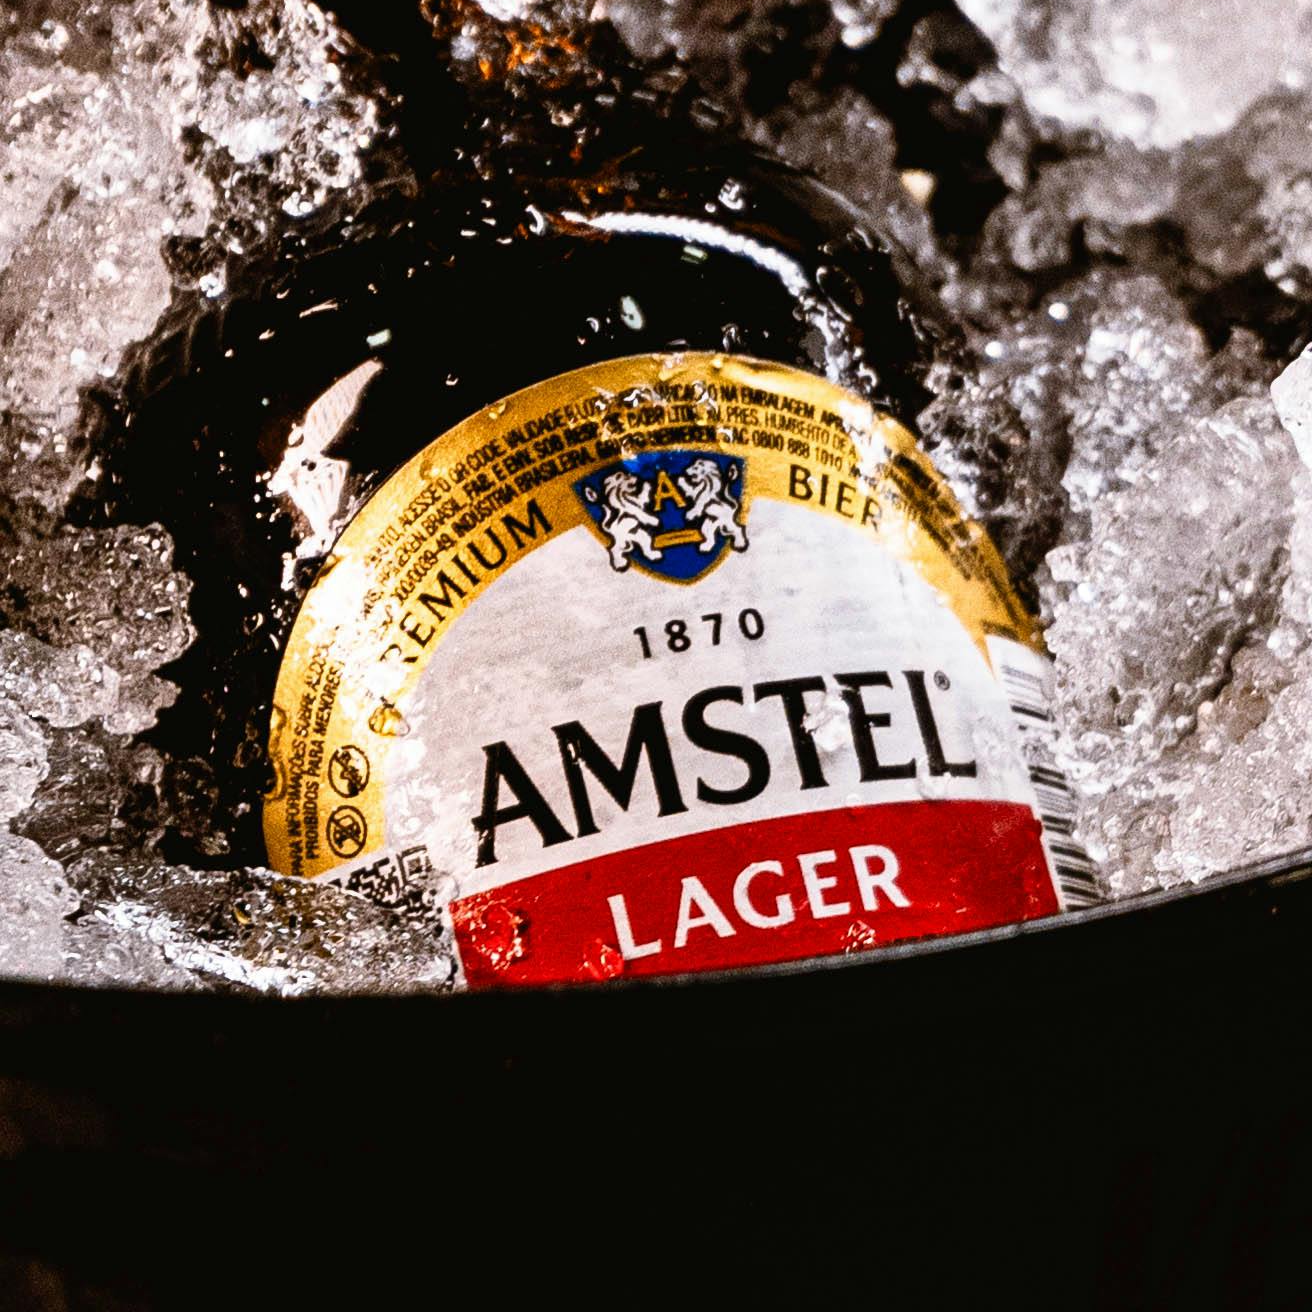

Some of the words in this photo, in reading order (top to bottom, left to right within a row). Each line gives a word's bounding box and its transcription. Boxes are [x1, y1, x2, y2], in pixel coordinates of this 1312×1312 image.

[752, 430, 784, 451] 0800
[787, 462, 886, 534] BIER
[366, 499, 556, 710] REMIUM
[633, 606, 767, 660] 1870
[313, 667, 340, 736] MENORES
[305, 740, 324, 778] PARA
[471, 669, 977, 869] AMSTEL
[303, 782, 320, 860] PROIBIDOS
[605, 843, 912, 962] LAGER
